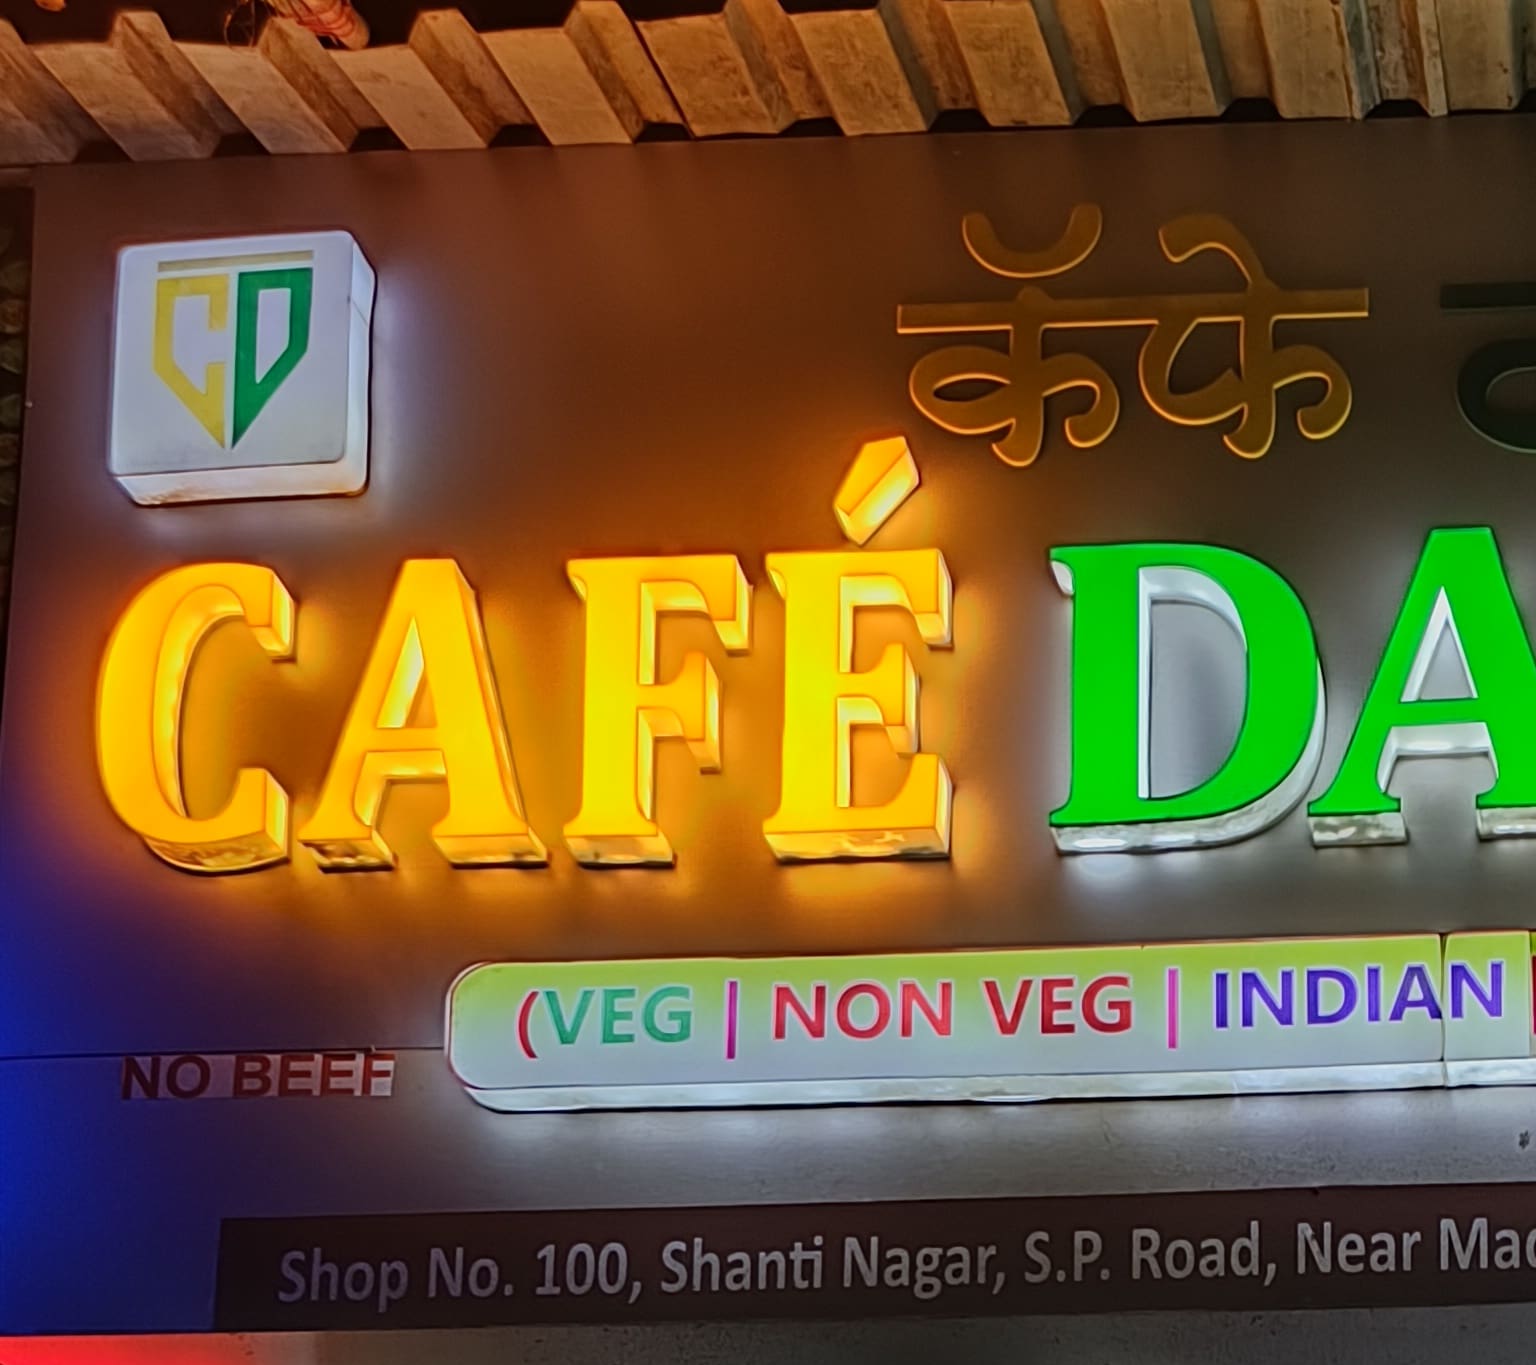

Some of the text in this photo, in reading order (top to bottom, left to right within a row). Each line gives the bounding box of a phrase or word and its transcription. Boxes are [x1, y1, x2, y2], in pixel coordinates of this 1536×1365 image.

[95, 435, 954, 873] CAFÉ
[772, 980, 953, 1041] NON
[983, 975, 1134, 1036] VEG
[1212, 959, 1505, 1030] INDIAN
[121, 1053, 396, 1099] NO BEEF
[279, 1247, 409, 1313] Shop
[428, 1247, 514, 1300] No.
[535, 1242, 643, 1304] 100,
[660, 1234, 825, 1294] Shanti
[842, 1235, 1006, 1300] Nagar,
[1024, 1230, 1111, 1284] S.P.
[1131, 1220, 1277, 1287] Road,
[1295, 1220, 1420, 1275] Near
